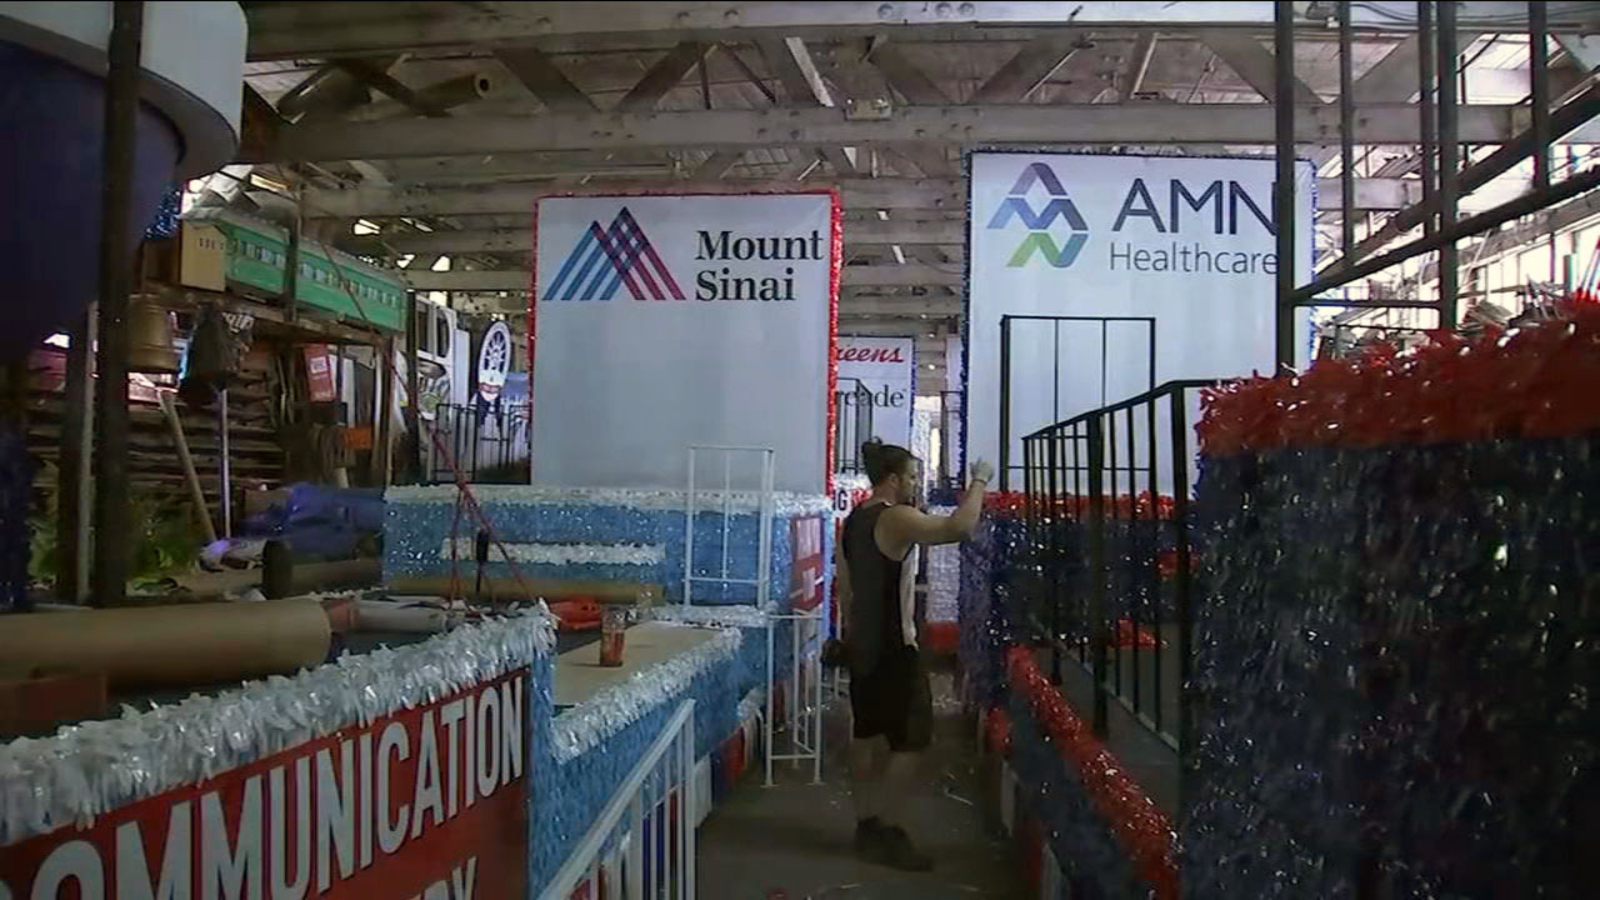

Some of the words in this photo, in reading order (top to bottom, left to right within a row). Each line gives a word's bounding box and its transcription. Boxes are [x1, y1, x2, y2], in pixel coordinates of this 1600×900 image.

[1112, 177, 1277, 236] AMN
[695, 230, 824, 261] Mount
[1110, 241, 1278, 275] Healthcare
[695, 267, 796, 301] Sinai
